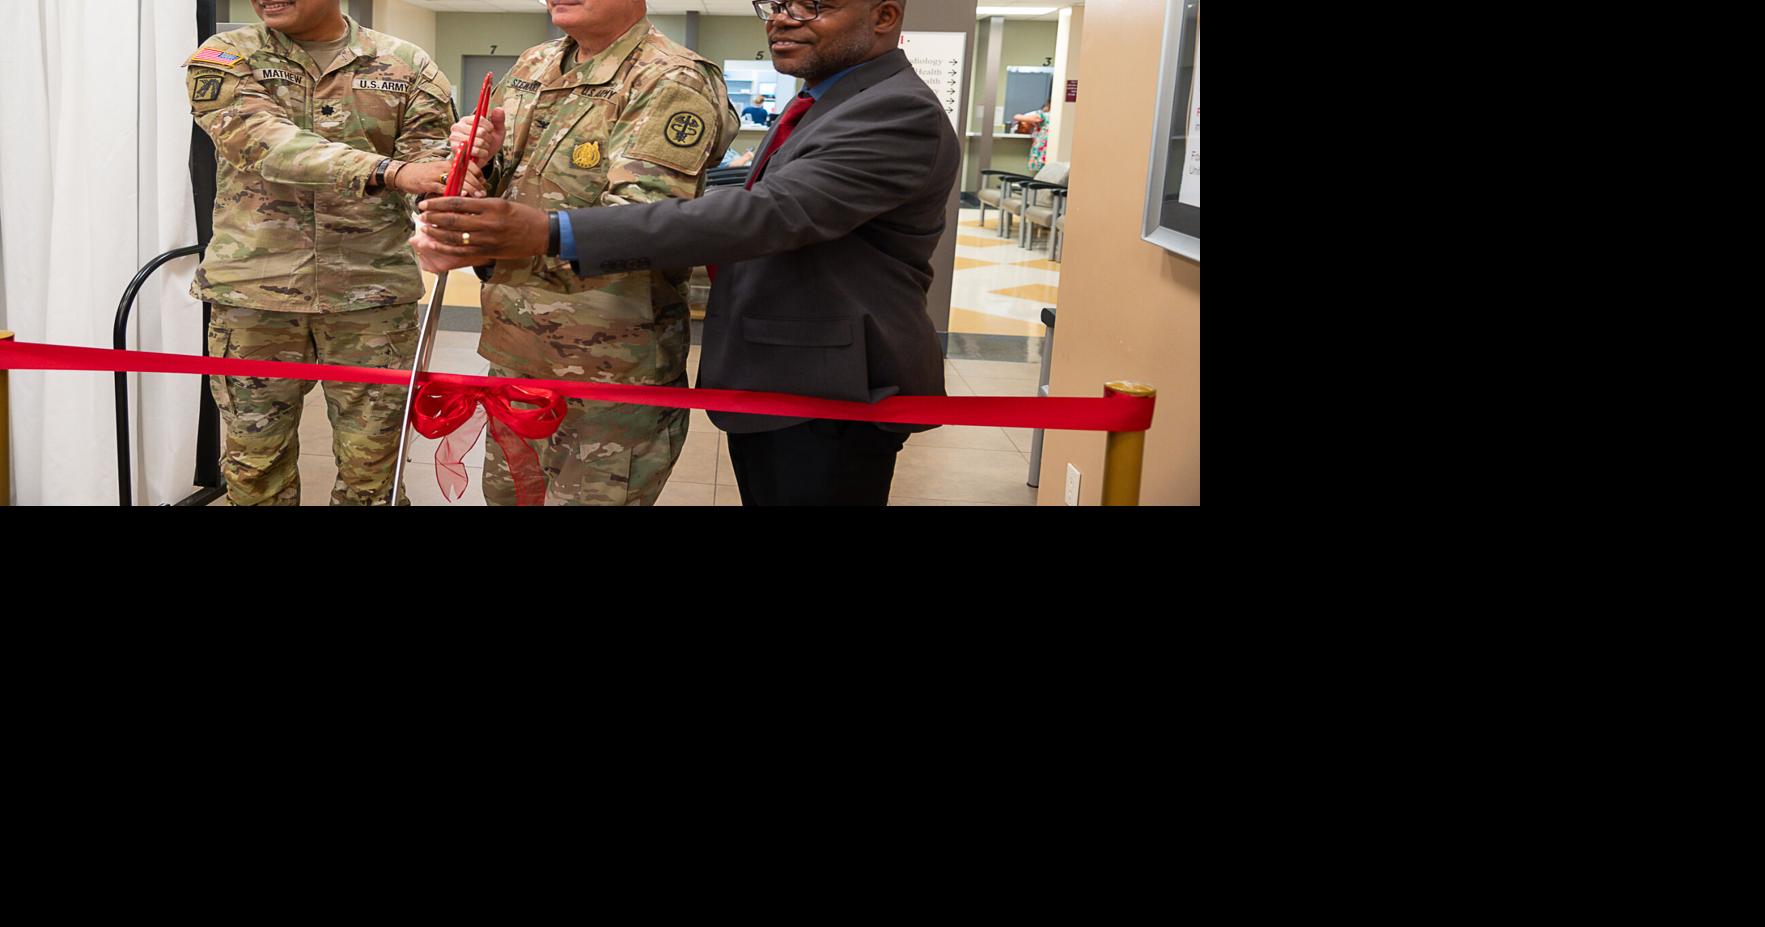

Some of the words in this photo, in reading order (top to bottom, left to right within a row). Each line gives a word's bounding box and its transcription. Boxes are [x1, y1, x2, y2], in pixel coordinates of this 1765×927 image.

[490, 45, 497, 55] 7
[755, 50, 765, 61] 5
[1042, 57, 1052, 67] 3
[262, 69, 302, 84] MATHEW
[360, 80, 380, 89] U.S.
[381, 81, 410, 92] ARMY
